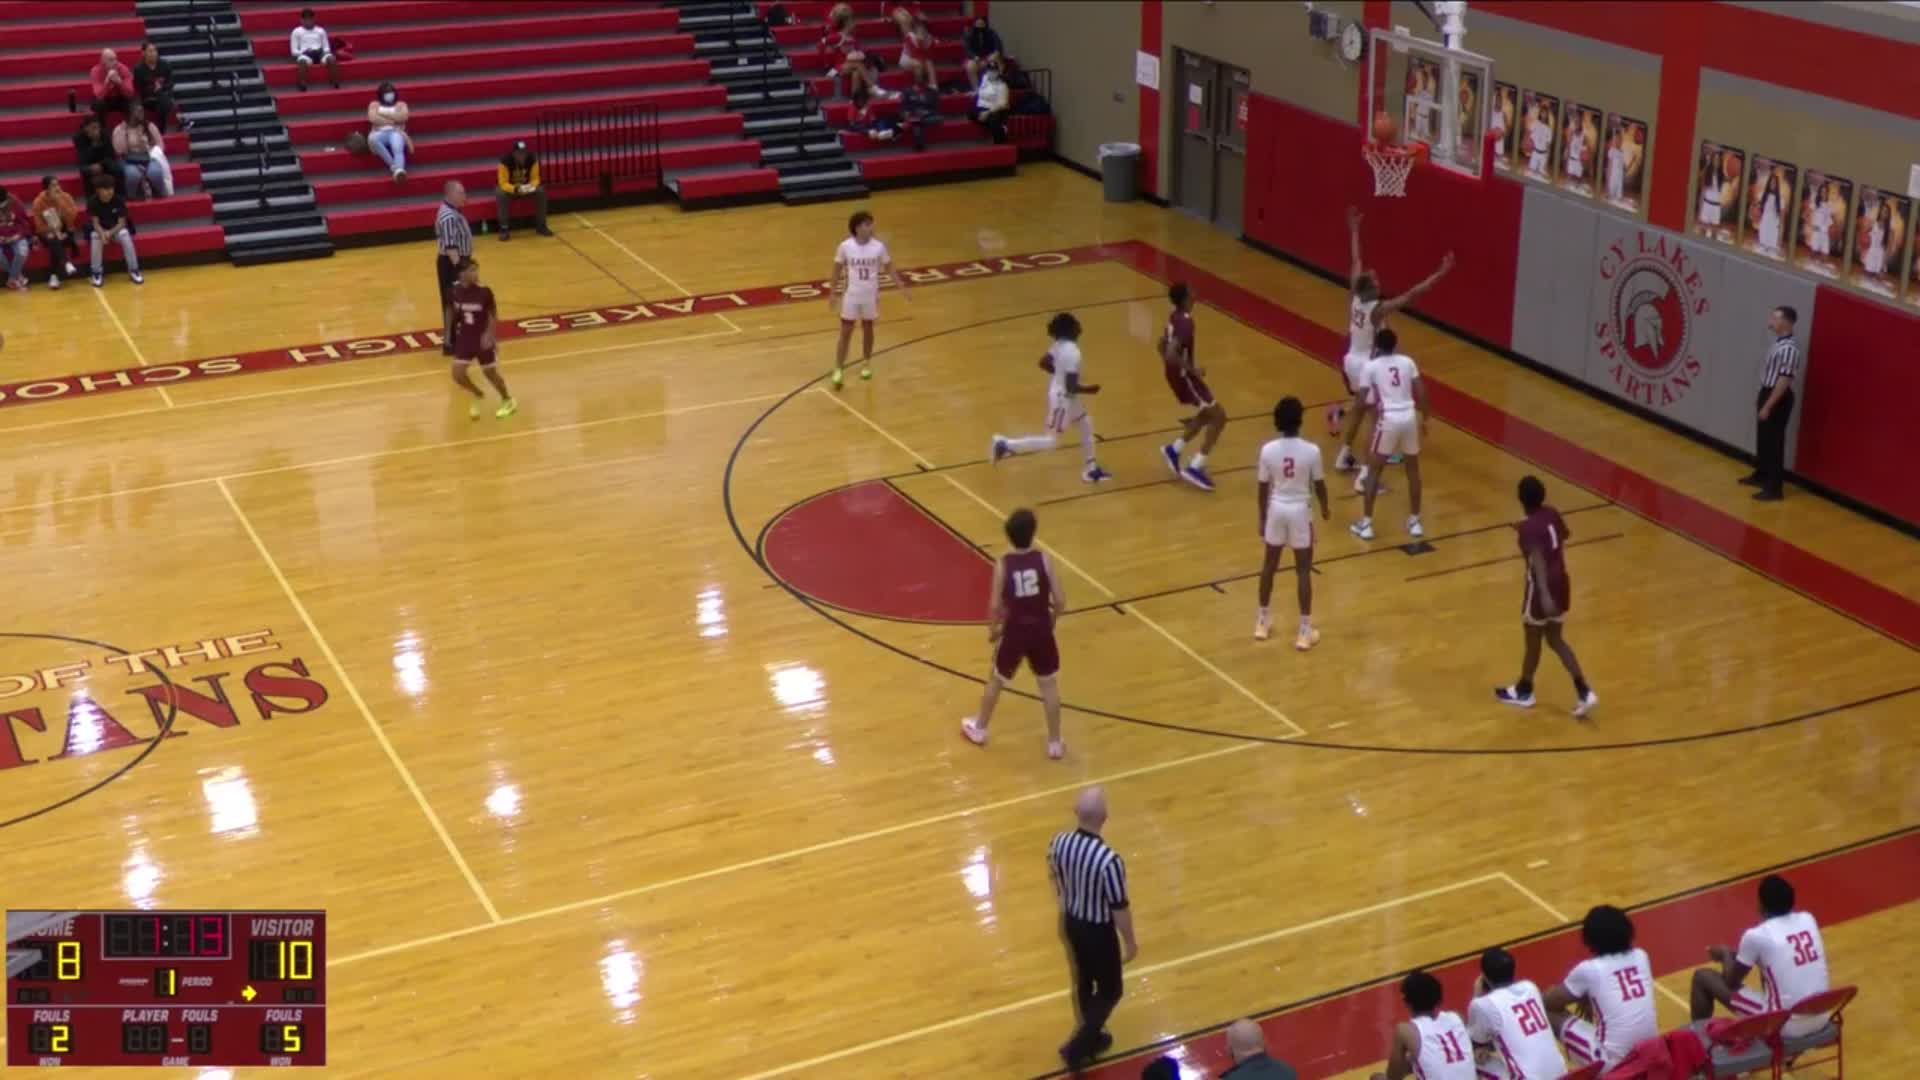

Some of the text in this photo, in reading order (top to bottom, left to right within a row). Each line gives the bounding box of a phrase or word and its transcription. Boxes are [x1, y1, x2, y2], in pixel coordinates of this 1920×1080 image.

[1600, 232, 1711, 316] CY LAKES
[517, 293, 748, 333] LAKES
[0, 358, 242, 398] SCHO
[1388, 366, 1401, 387] 3
[1595, 320, 1701, 407] SPARTANS
[1283, 457, 1295, 479] 2
[1547, 523, 1559, 549] 1
[1012, 567, 1040, 598] 12
[0, 628, 282, 698] OF THE
[0, 656, 329, 770] TANS
[1785, 930, 1819, 967] 32
[1613, 965, 1646, 1002] 15
[1511, 997, 1549, 1037] 20
[1434, 1029, 1465, 1064] 11
